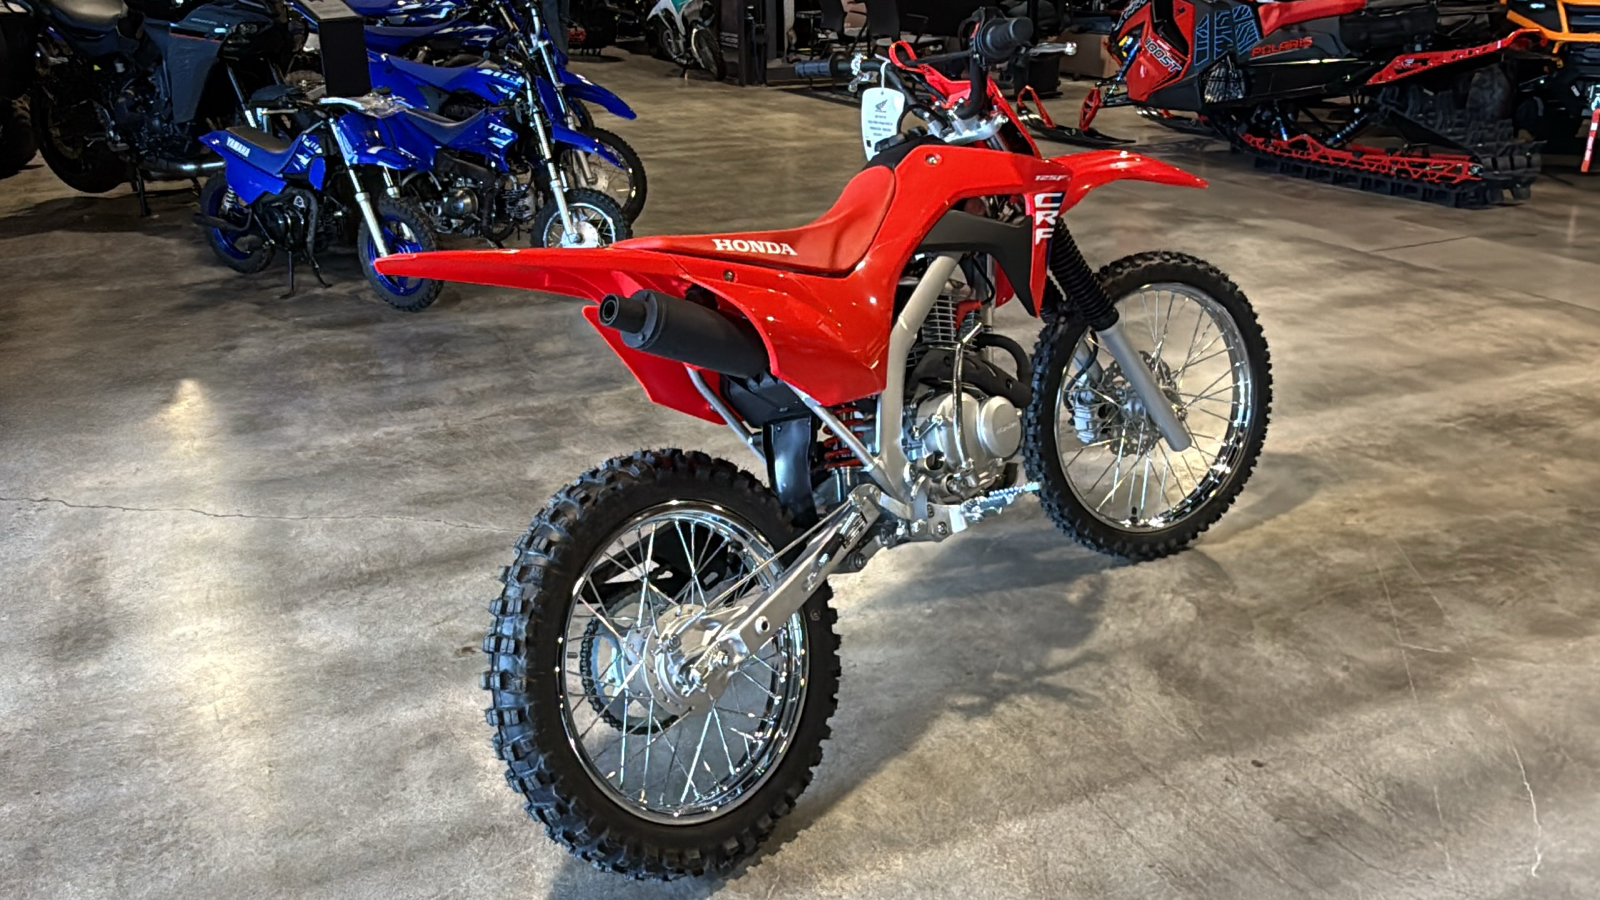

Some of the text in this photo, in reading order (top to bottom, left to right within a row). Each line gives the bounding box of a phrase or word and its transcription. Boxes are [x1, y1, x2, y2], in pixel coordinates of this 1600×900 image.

[1251, 36, 1313, 57] POLARIS
[226, 136, 251, 158] YAMAHA
[1034, 192, 1063, 246] CRF
[711, 238, 798, 256] HONDA
